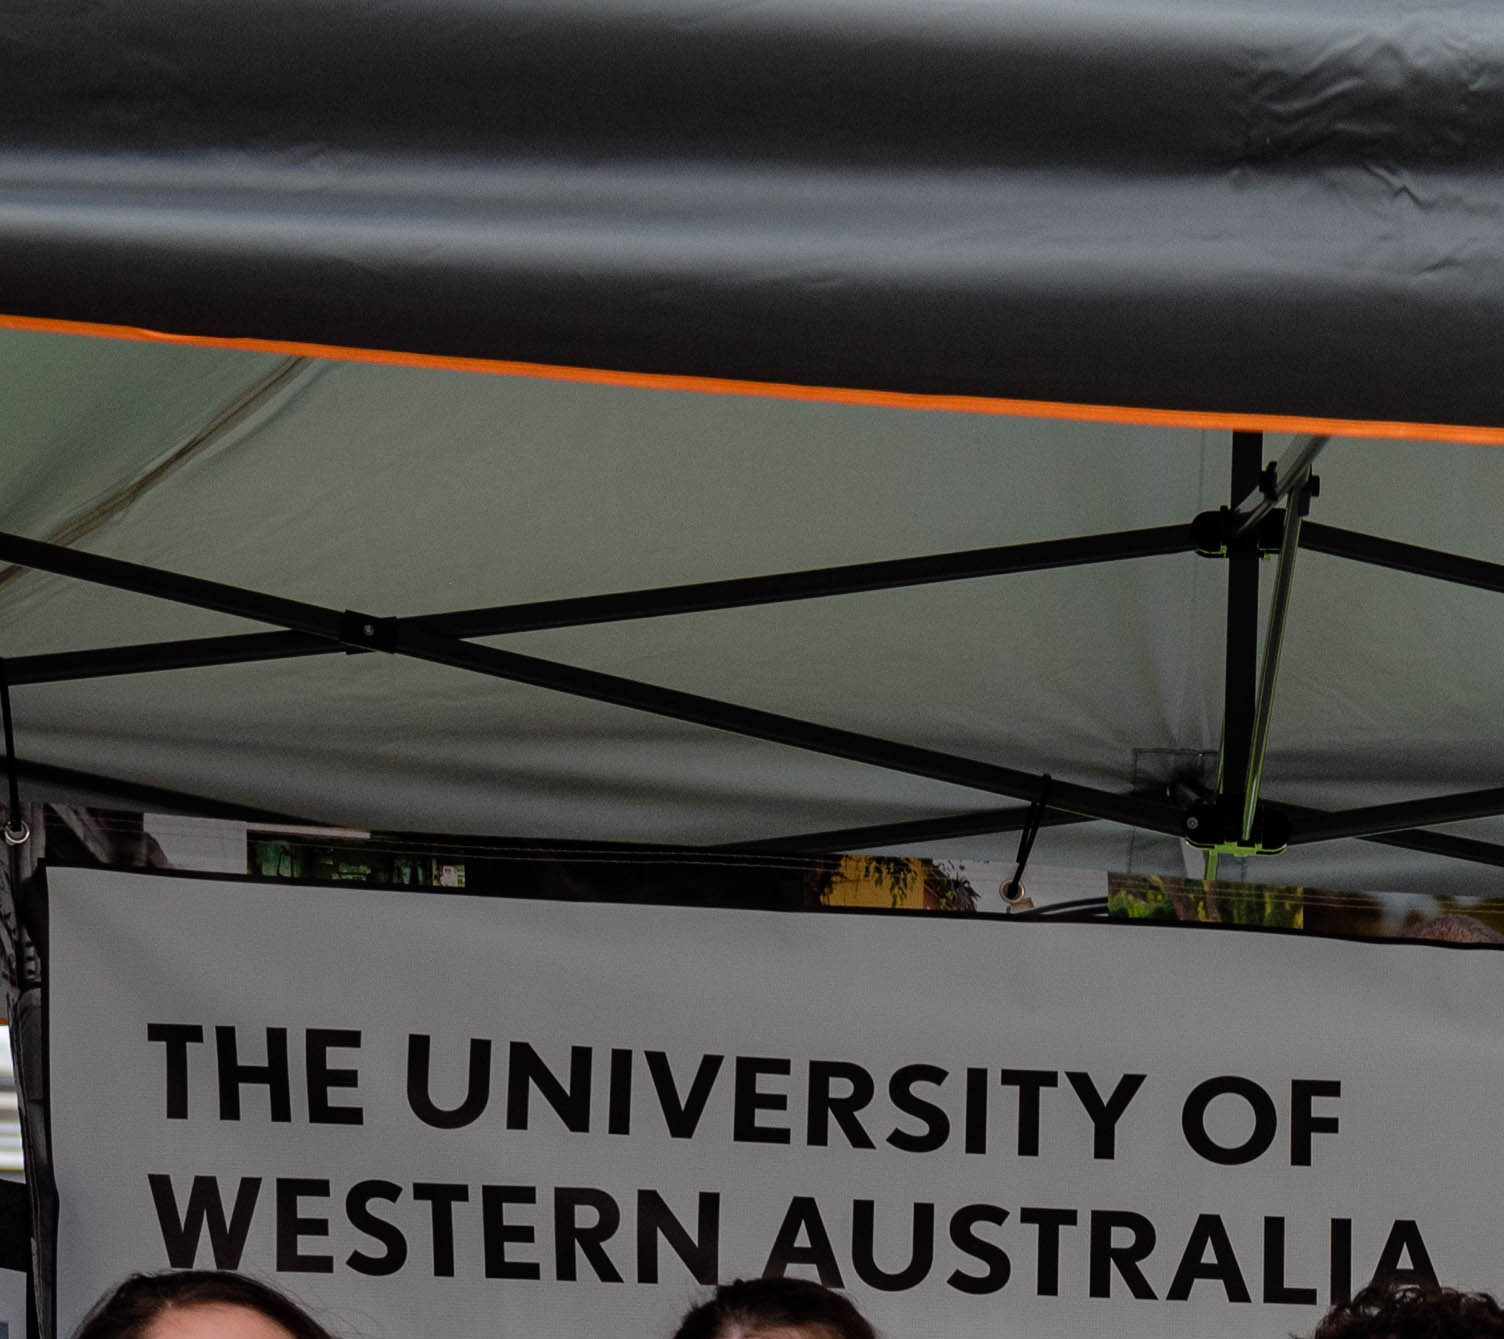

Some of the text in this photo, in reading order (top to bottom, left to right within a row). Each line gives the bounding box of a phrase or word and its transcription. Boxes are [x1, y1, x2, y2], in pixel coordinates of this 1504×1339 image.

[148, 1023, 1342, 1167] THE UNIVERSITY OF
[148, 1174, 1442, 1305] WESTERN AUSTRALIA
